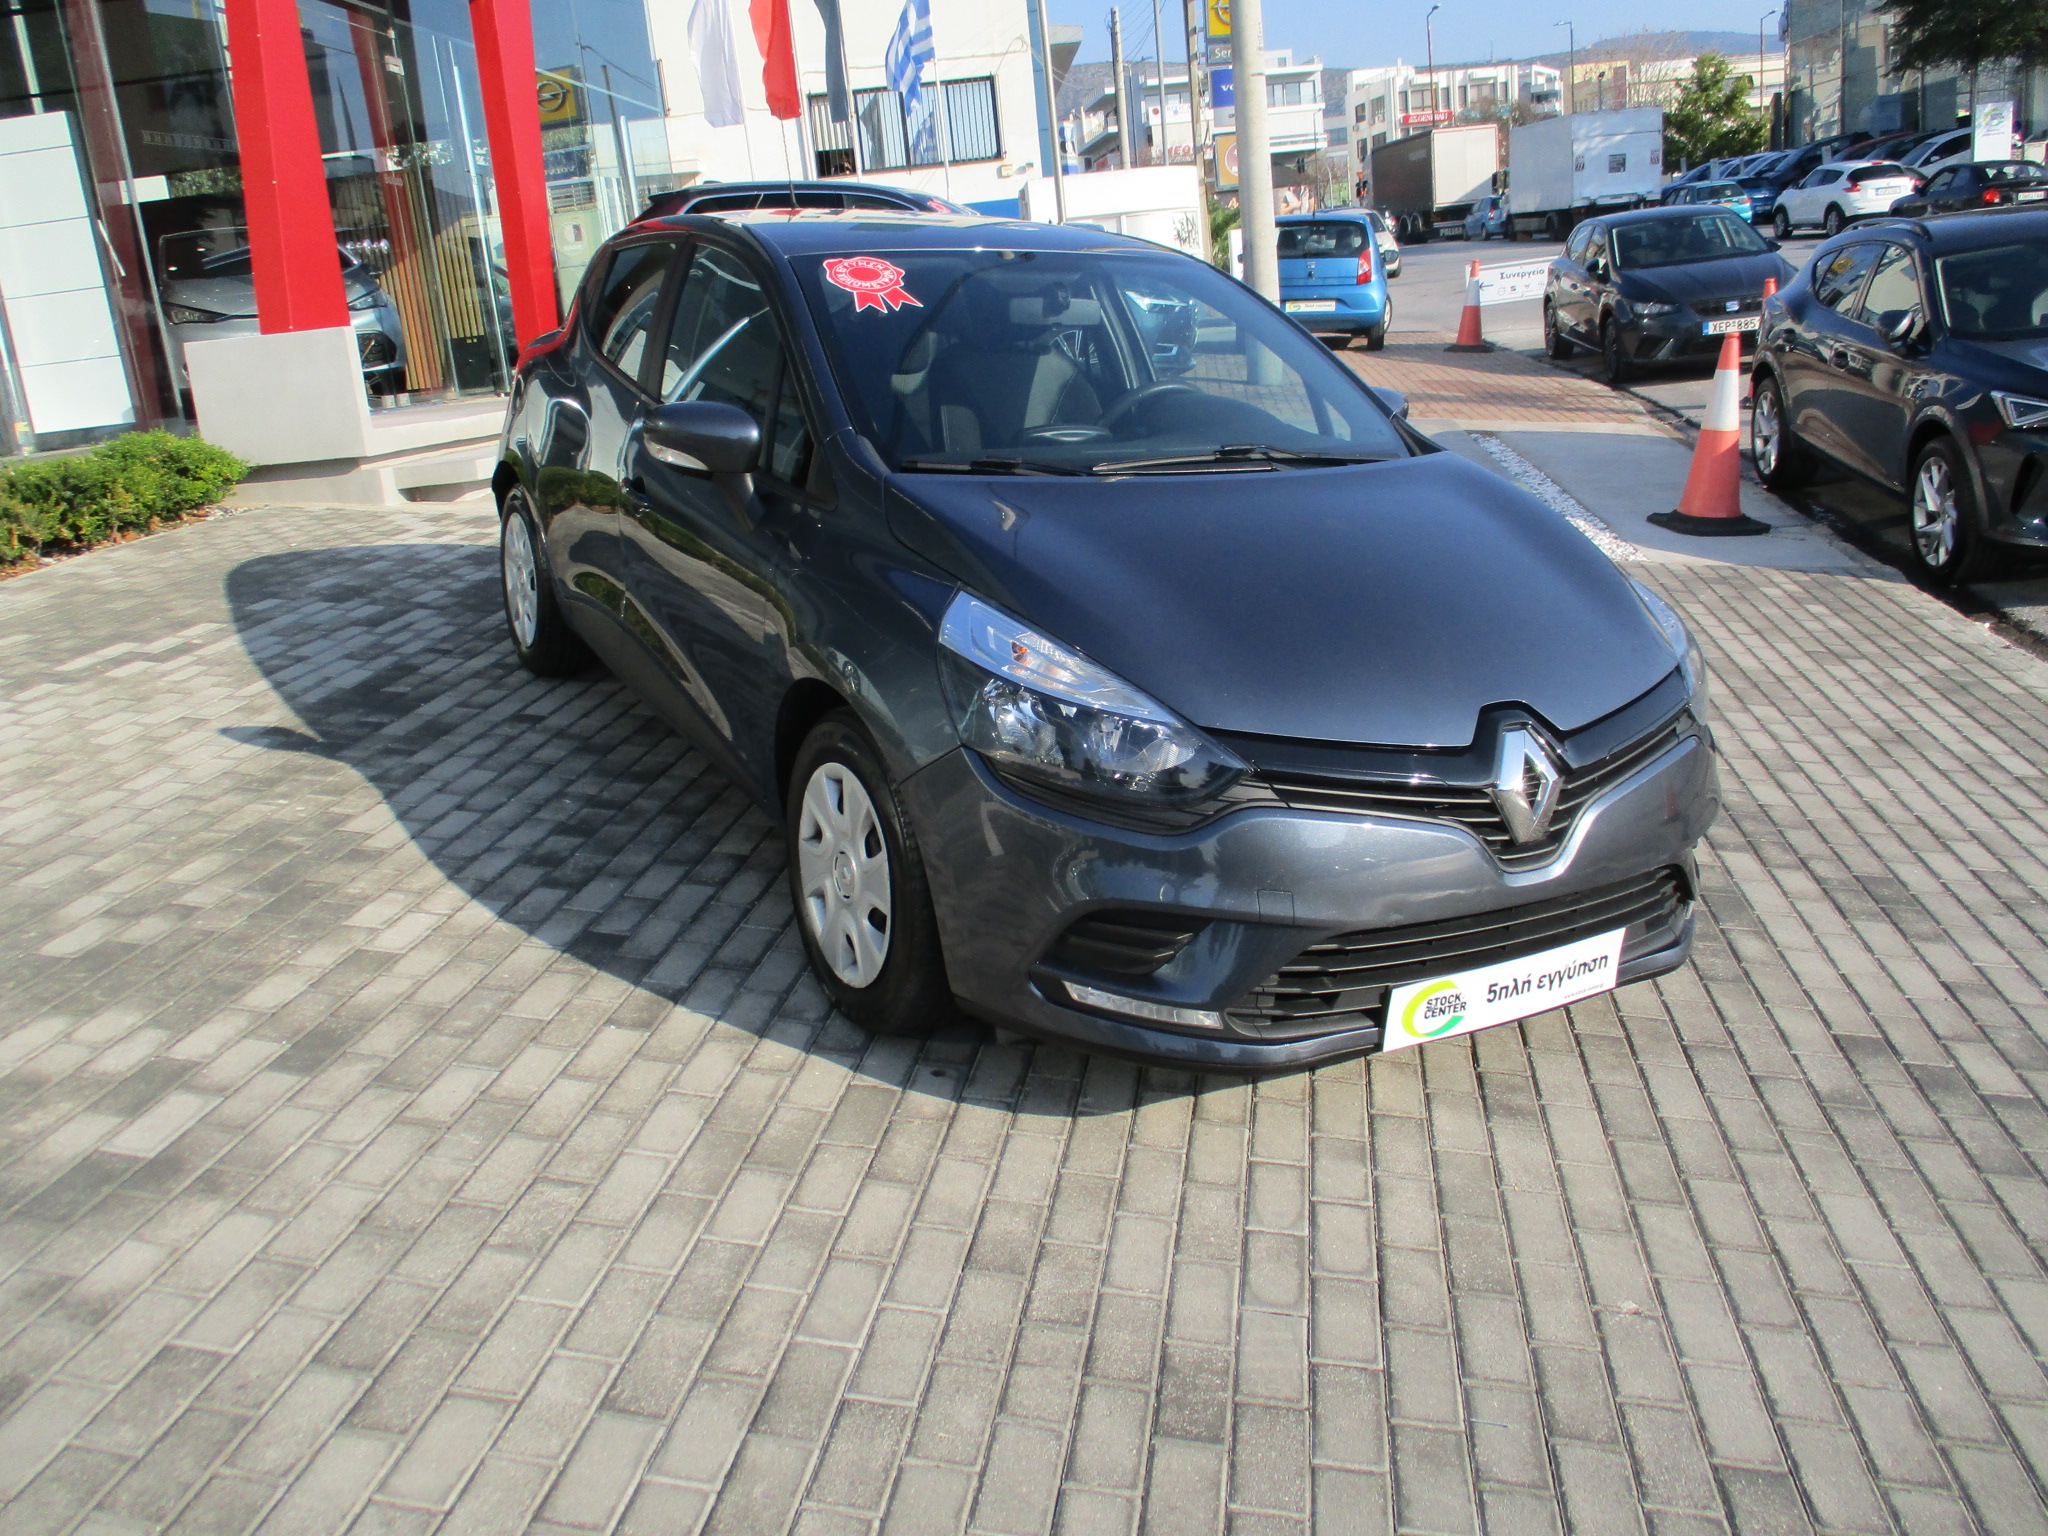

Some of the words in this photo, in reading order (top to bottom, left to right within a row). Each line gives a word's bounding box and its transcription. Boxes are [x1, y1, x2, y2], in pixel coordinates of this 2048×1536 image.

[1499, 268, 1545, 280] Συνεργείο
[1486, 973, 1532, 1003] 5πλή
[1426, 992, 1462, 1007] STOCK
[1424, 1002, 1467, 1019] CENTER
